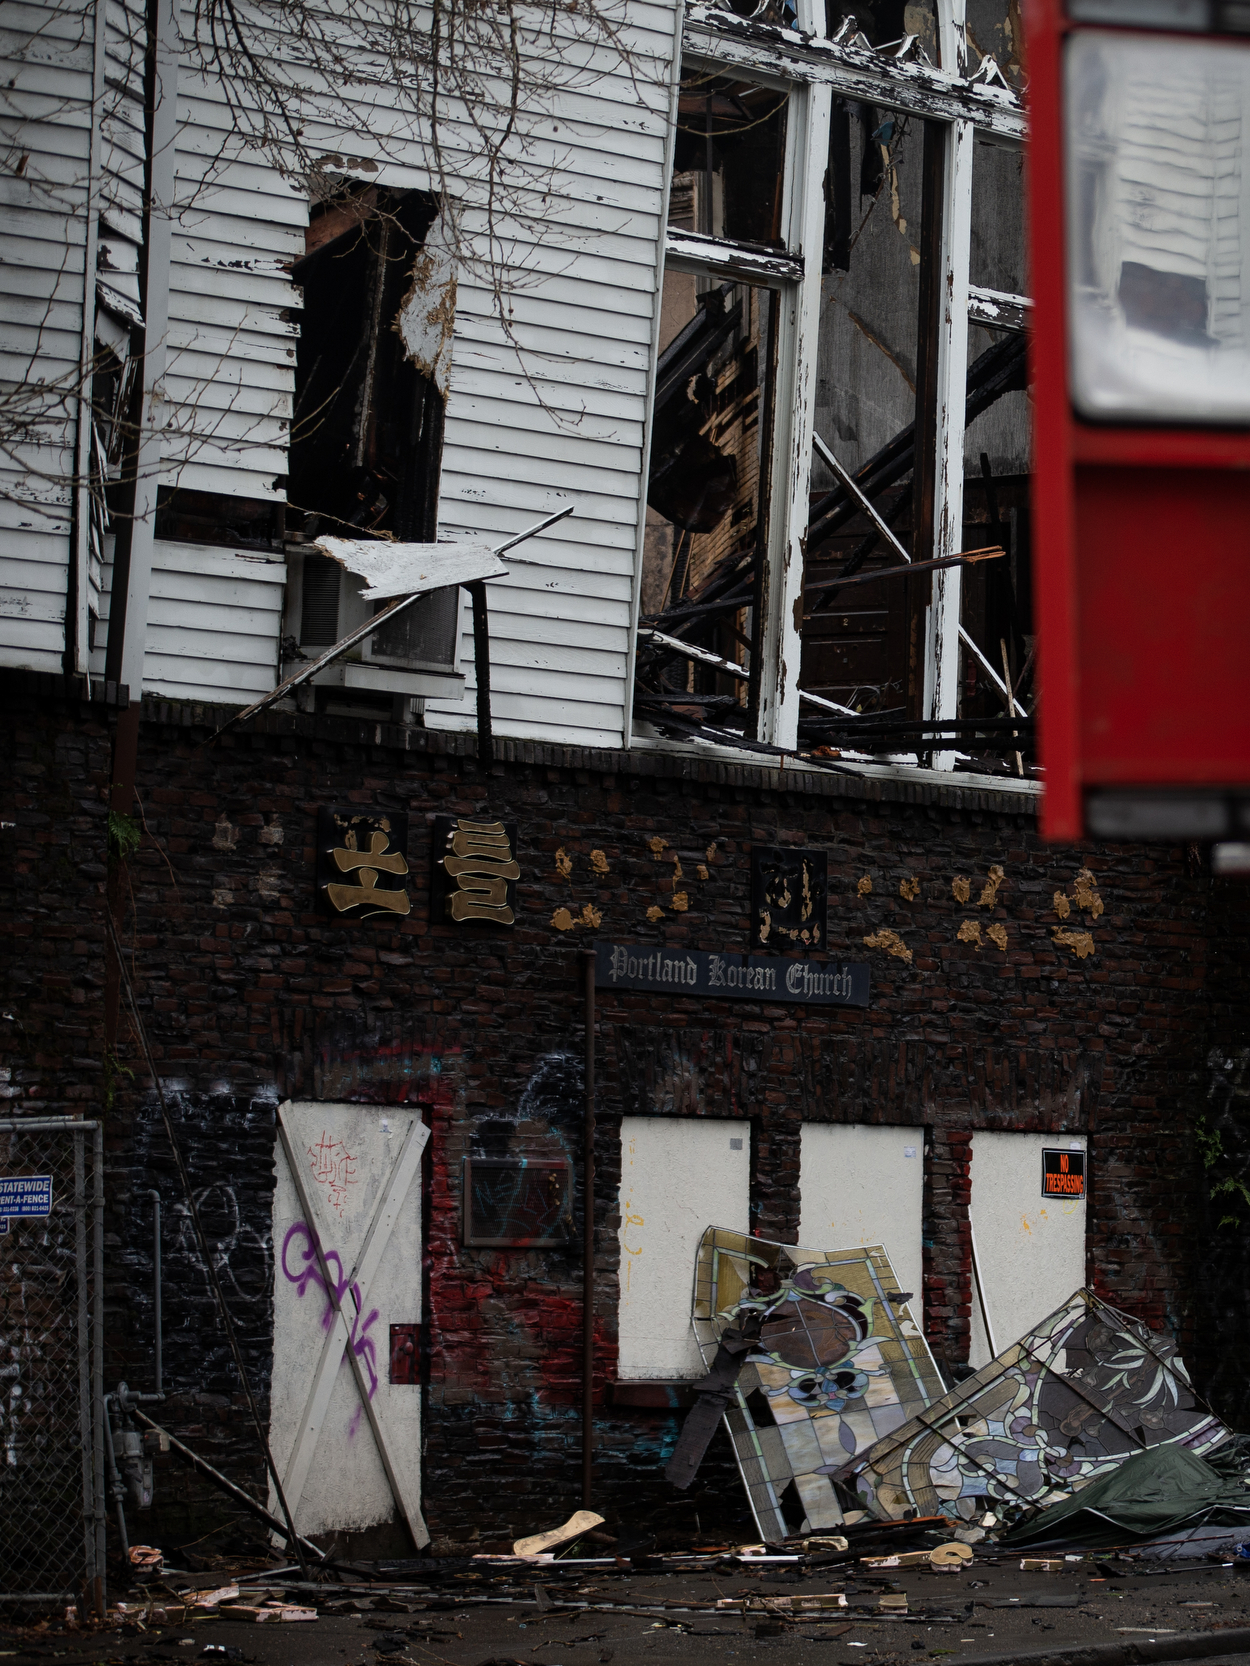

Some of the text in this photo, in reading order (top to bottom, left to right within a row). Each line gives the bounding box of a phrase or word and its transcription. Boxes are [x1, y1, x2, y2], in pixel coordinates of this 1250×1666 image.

[609, 945, 853, 1000] Portland Korean Church
[1060, 1154, 1069, 1173] NO
[0, 1181, 50, 1193] STATEWIDE
[1046, 1173, 1084, 1194] TRESPASSING
[0, 1194, 49, 1205] ENT-A-FENCE
